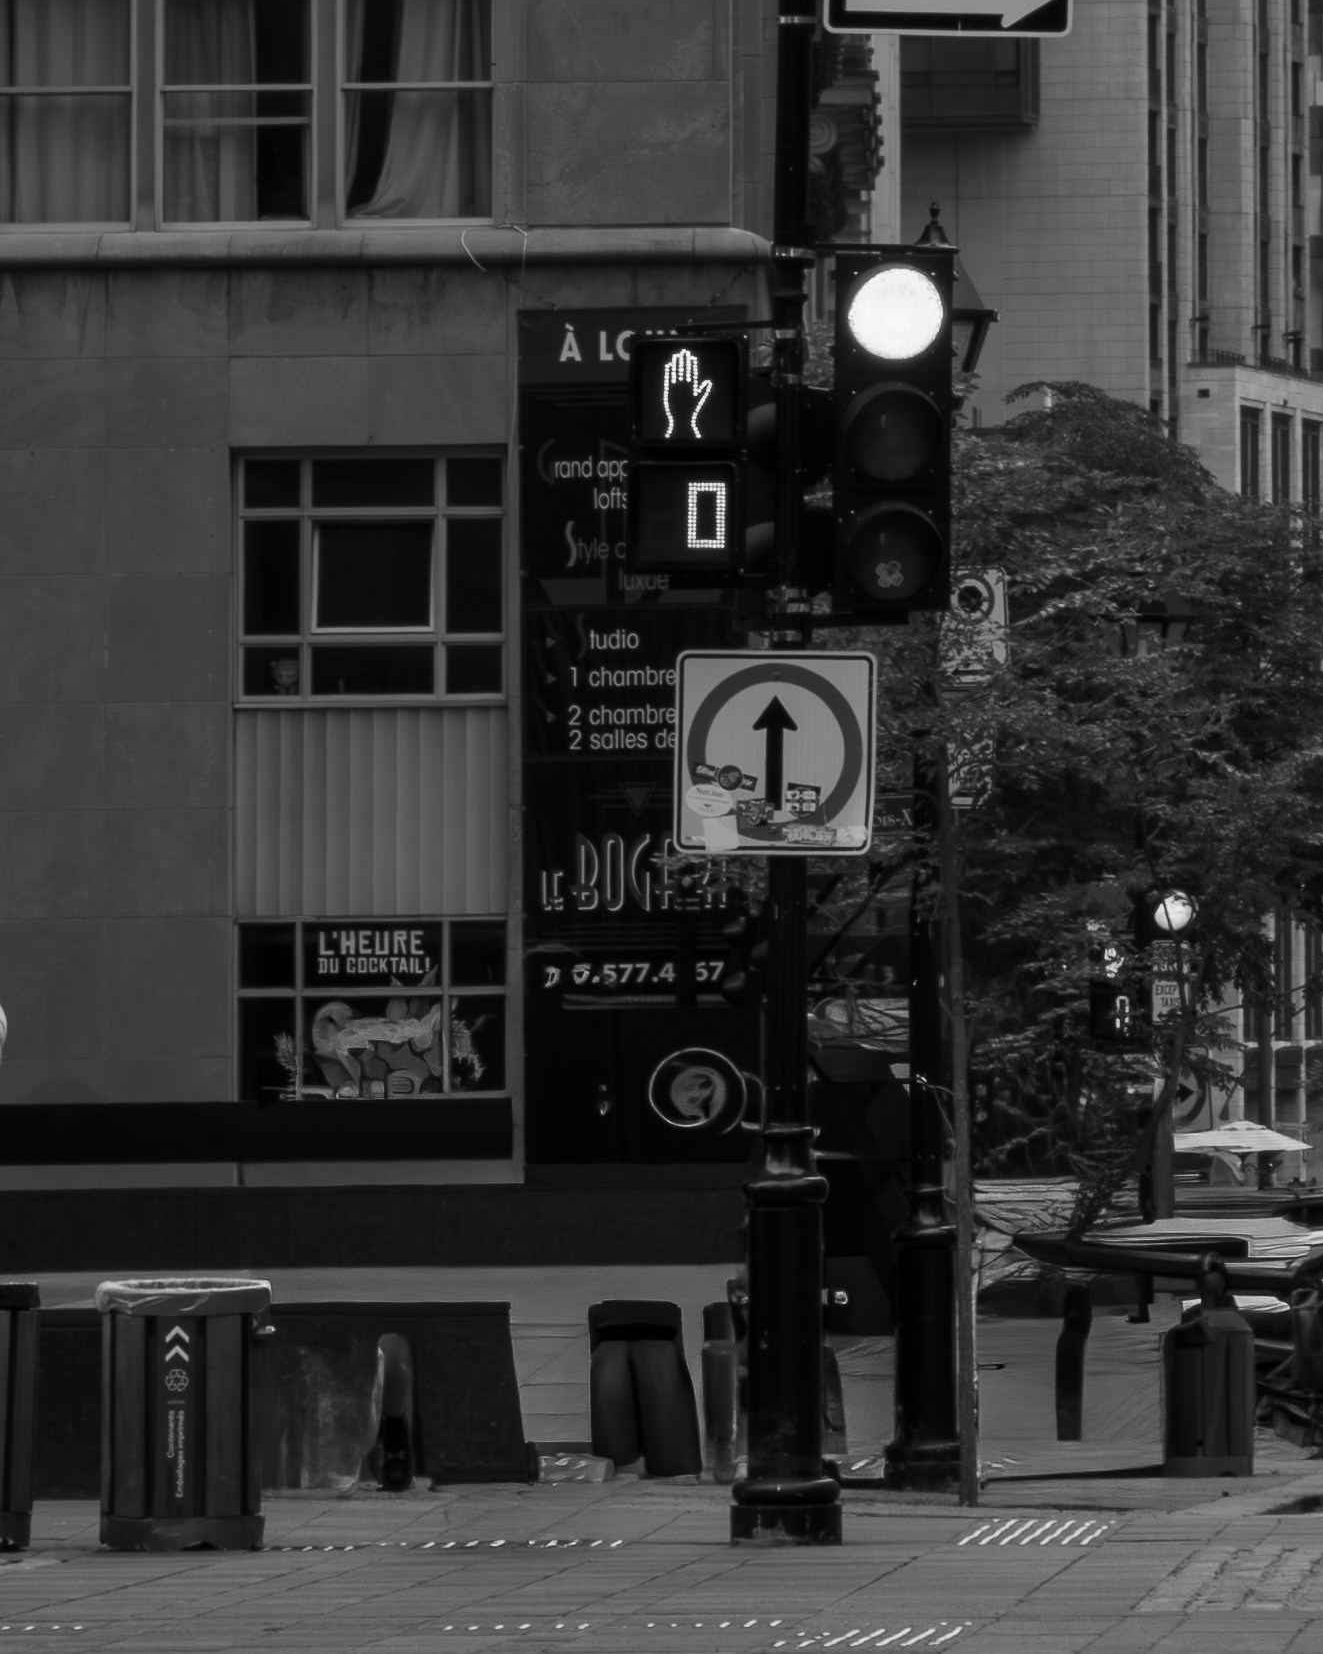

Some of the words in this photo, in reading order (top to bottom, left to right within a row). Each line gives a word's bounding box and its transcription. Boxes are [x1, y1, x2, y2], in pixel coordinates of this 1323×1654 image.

[560, 323, 582, 362] À
[687, 482, 726, 549] 0
[569, 666, 578, 687] 1
[568, 704, 581, 726] 2
[568, 729, 582, 750] 2
[589, 728, 649, 750] salles
[655, 728, 678, 749] de
[319, 930, 425, 955] L'HEURE
[318, 957, 340, 974] DU
[346, 957, 431, 974] COCKTAIL!
